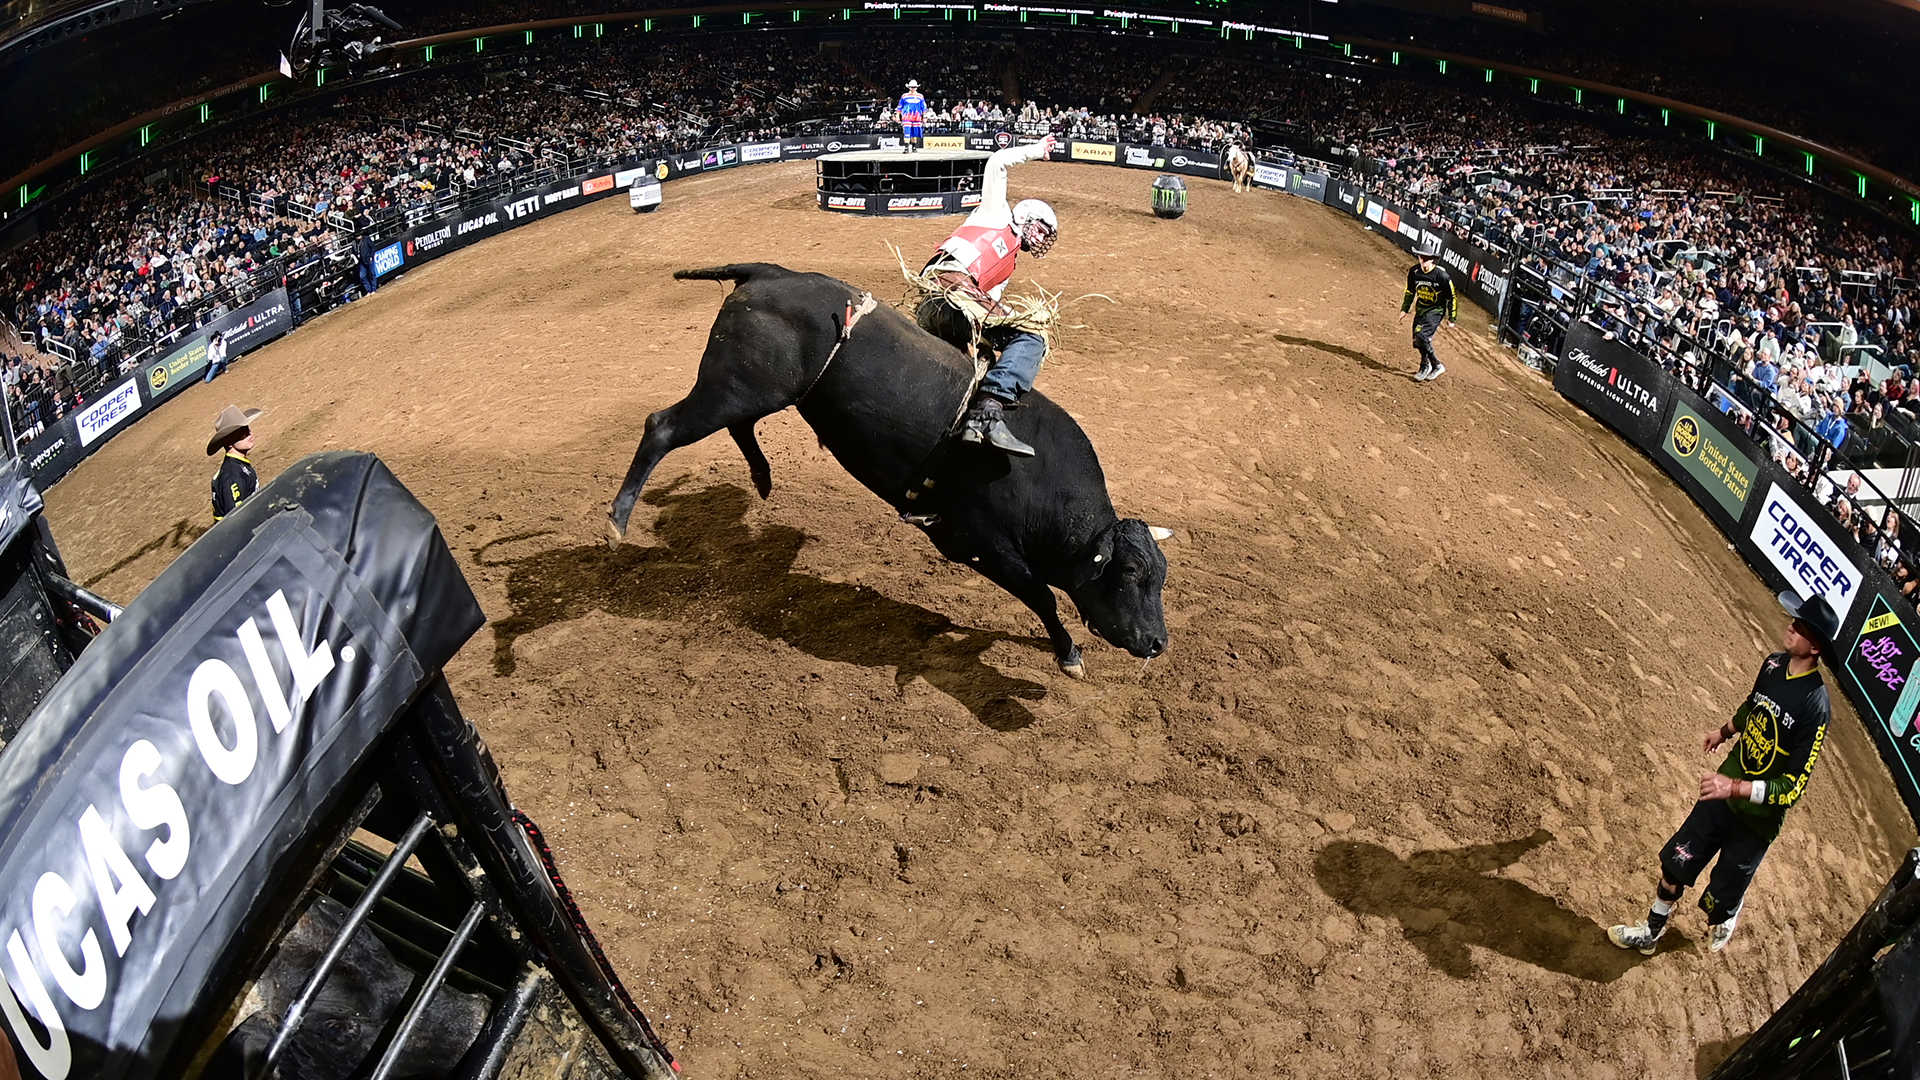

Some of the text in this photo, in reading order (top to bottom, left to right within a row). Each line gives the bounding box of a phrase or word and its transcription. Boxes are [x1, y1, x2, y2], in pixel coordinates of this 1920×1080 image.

[503, 195, 540, 220] YETI
[414, 225, 452, 250] PENDLETON
[457, 216, 484, 235] LUCAS
[1421, 228, 1442, 255] YETI
[375, 255, 400, 274] WORLD
[1442, 247, 1461, 268] LUCAS
[253, 303, 285, 323] ULTRA
[1568, 347, 1657, 412] Michelob ULTRA
[81, 385, 133, 428] COOPER
[90, 400, 127, 432] TIRES
[1698, 449, 1747, 502] Border Patrol
[1703, 438, 1749, 488] United States
[1768, 500, 1852, 598] COOPER
[1771, 528, 1831, 597] TIRES
[1868, 615, 1890, 631] NEW!
[1876, 635, 1903, 659] HOT
[1859, 638, 1906, 691] RELEASE
[1782, 712, 1795, 729] BY
[1804, 722, 1827, 774] PATROL
